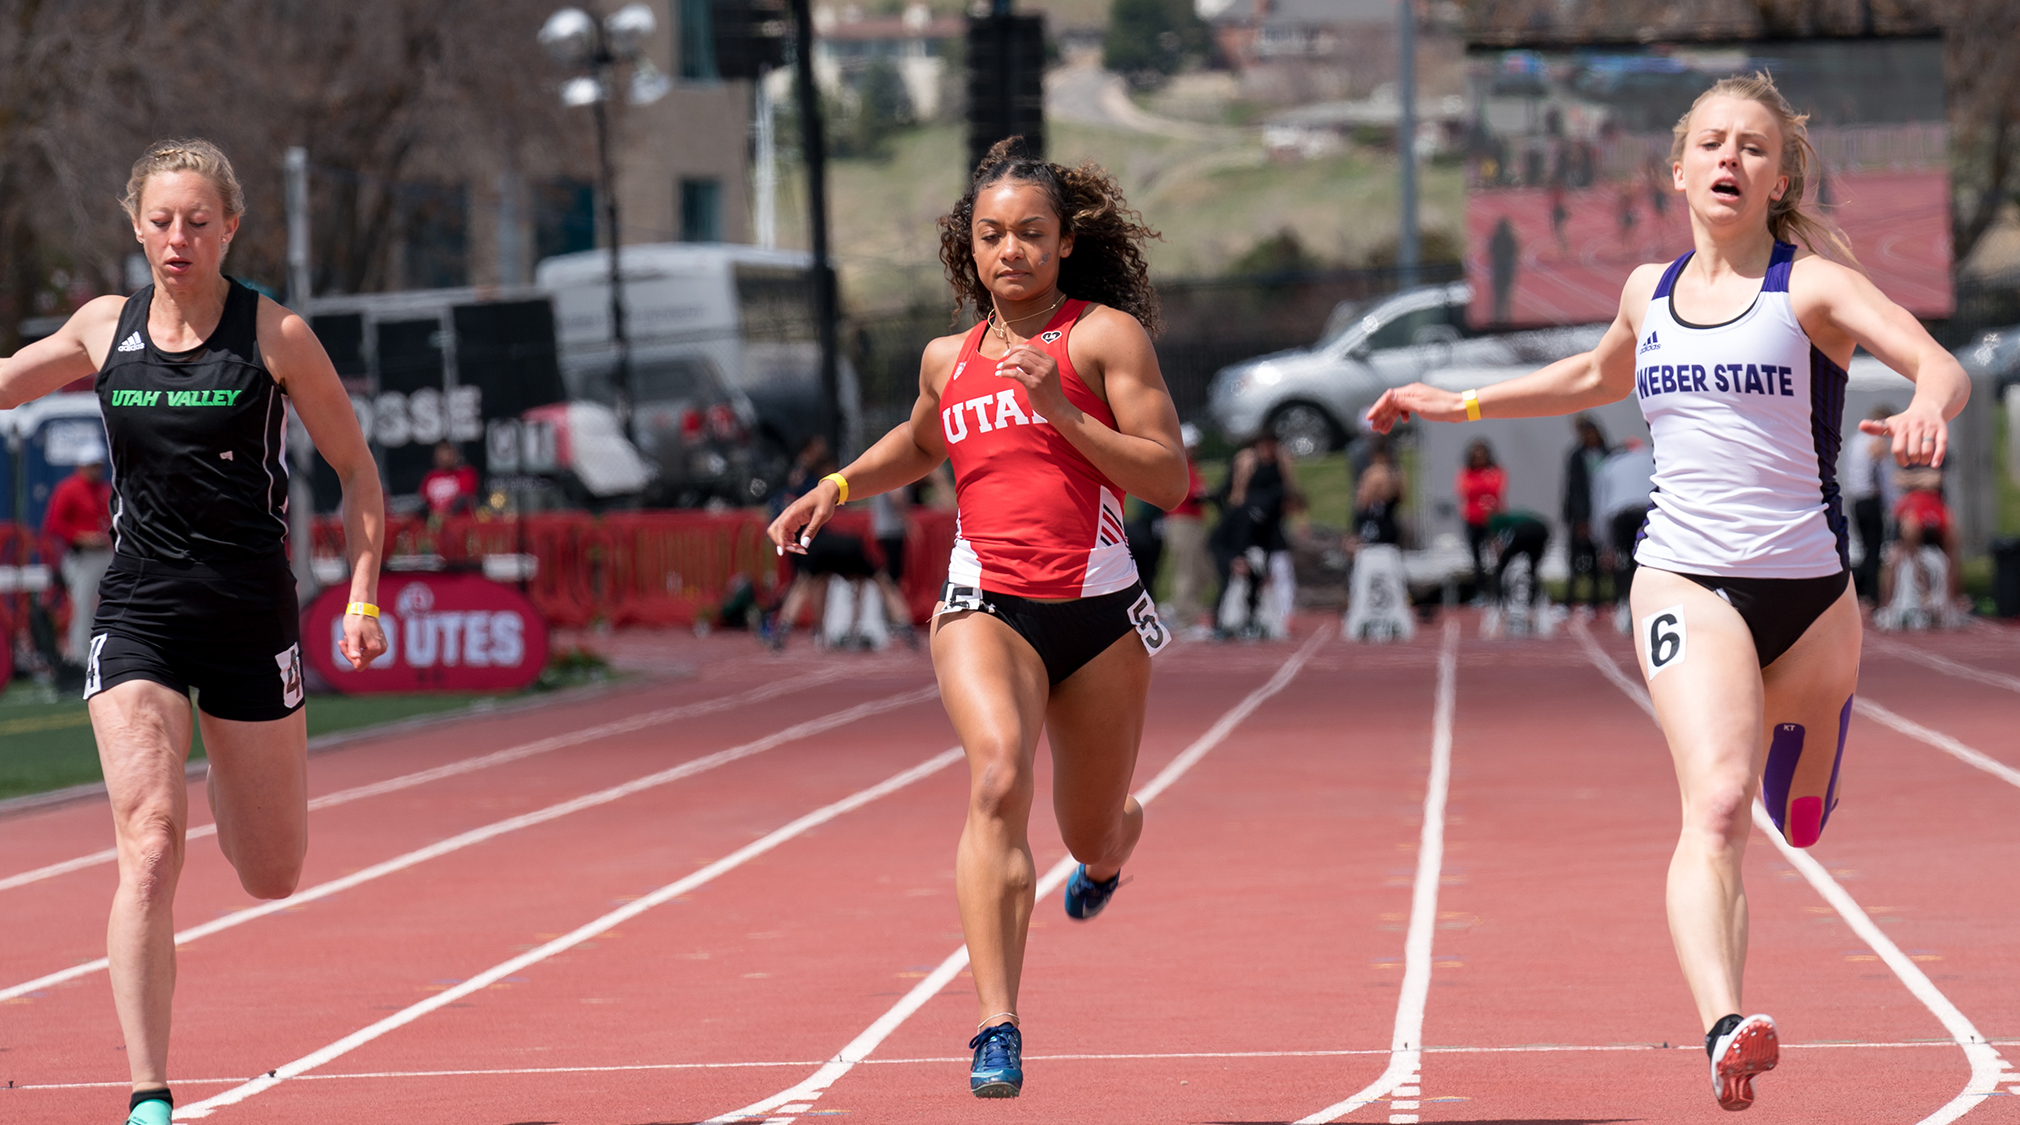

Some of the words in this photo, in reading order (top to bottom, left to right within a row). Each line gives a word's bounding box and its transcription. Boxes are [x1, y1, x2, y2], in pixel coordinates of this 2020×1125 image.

[117, 342, 145, 352] adidas
[1639, 343, 1661, 355] adidas
[111, 389, 162, 407] UTAH
[166, 389, 242, 407] VALLEY
[1636, 364, 1709, 400] WEBER
[1714, 363, 1795, 397] STATE
[404, 610, 524, 668] UTES
[1132, 597, 1164, 649] 5
[1650, 613, 1681, 668] 6
[286, 649, 300, 699] 4
[1783, 724, 1796, 732] KT
